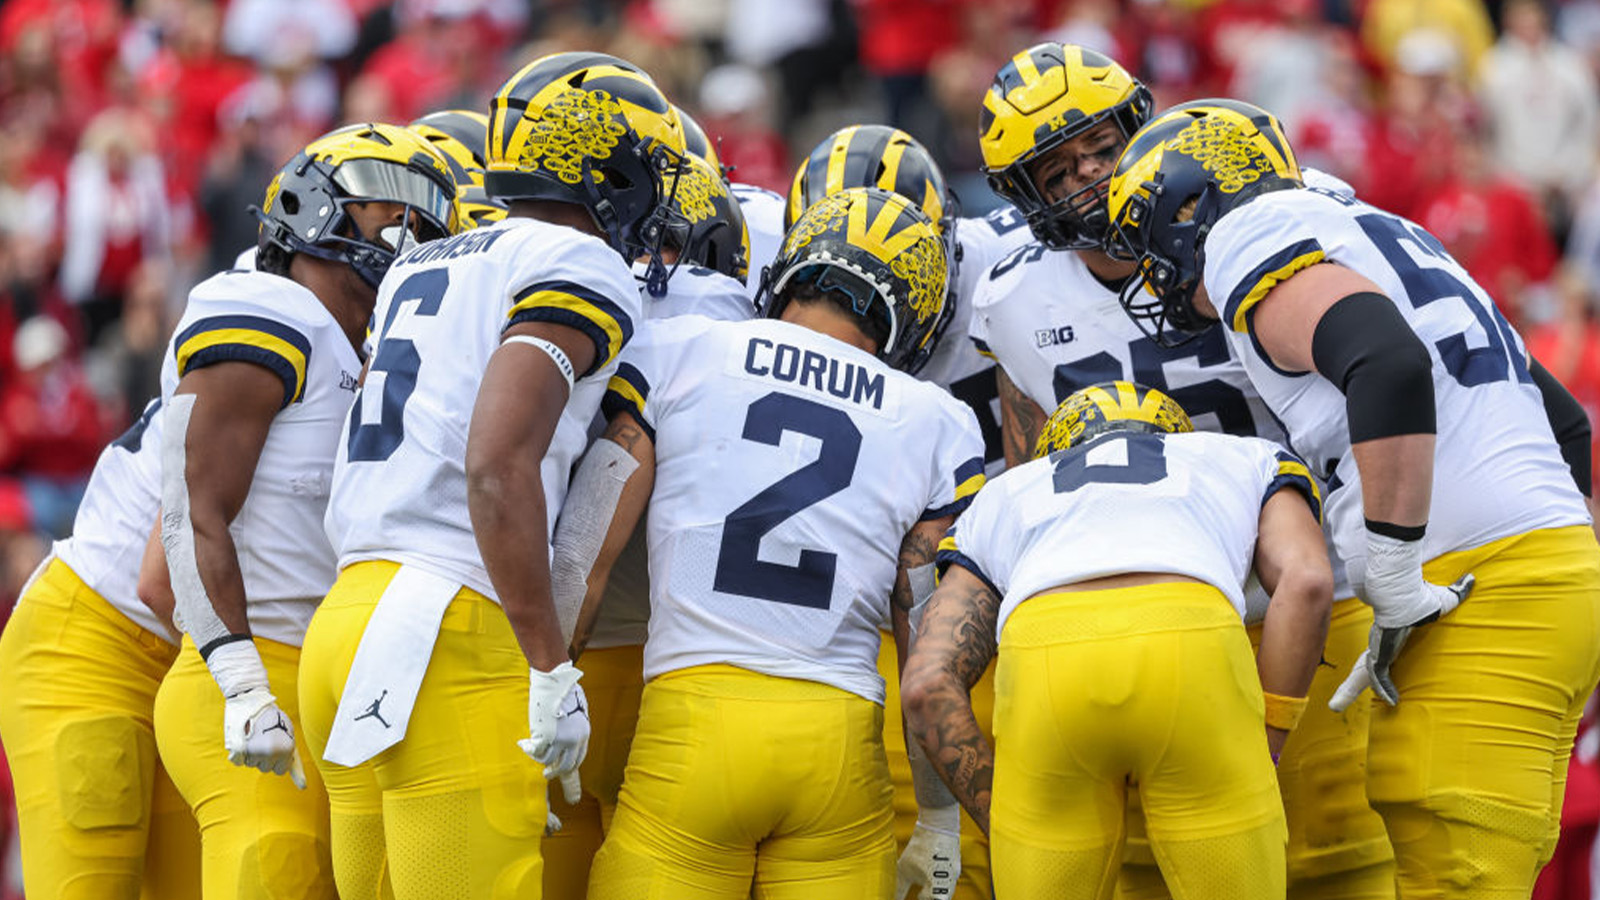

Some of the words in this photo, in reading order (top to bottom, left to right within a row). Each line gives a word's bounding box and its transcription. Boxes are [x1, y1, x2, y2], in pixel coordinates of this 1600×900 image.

[1254, 158, 1272, 173] 52
[347, 267, 449, 463] 6
[744, 337, 886, 410] CORUM
[712, 391, 863, 611] 2
[932, 854, 950, 900] JOR
